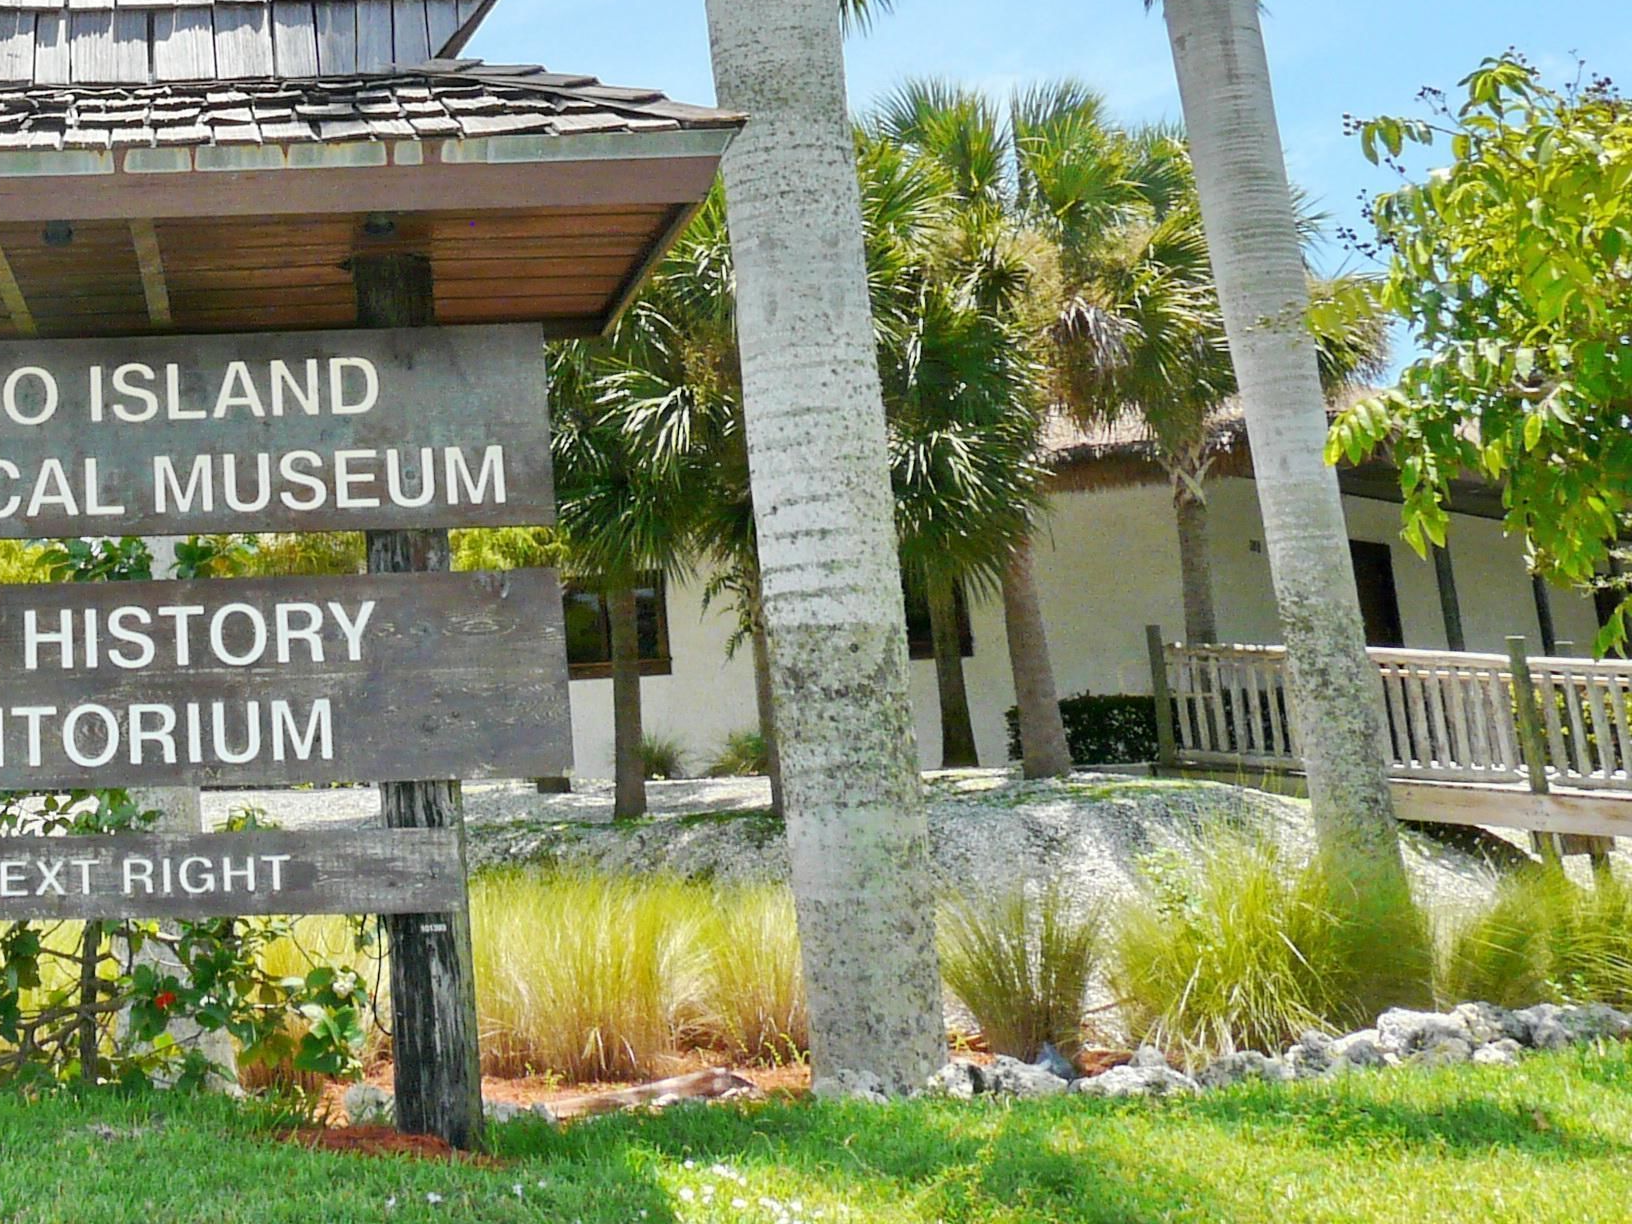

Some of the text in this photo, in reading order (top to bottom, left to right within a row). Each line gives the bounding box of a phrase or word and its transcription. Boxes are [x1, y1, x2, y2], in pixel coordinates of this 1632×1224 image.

[90, 357, 379, 423] ISLAND
[153, 445, 506, 513] MUSEUM
[24, 601, 376, 670] HISTORY
[122, 855, 291, 895] RIGHT
